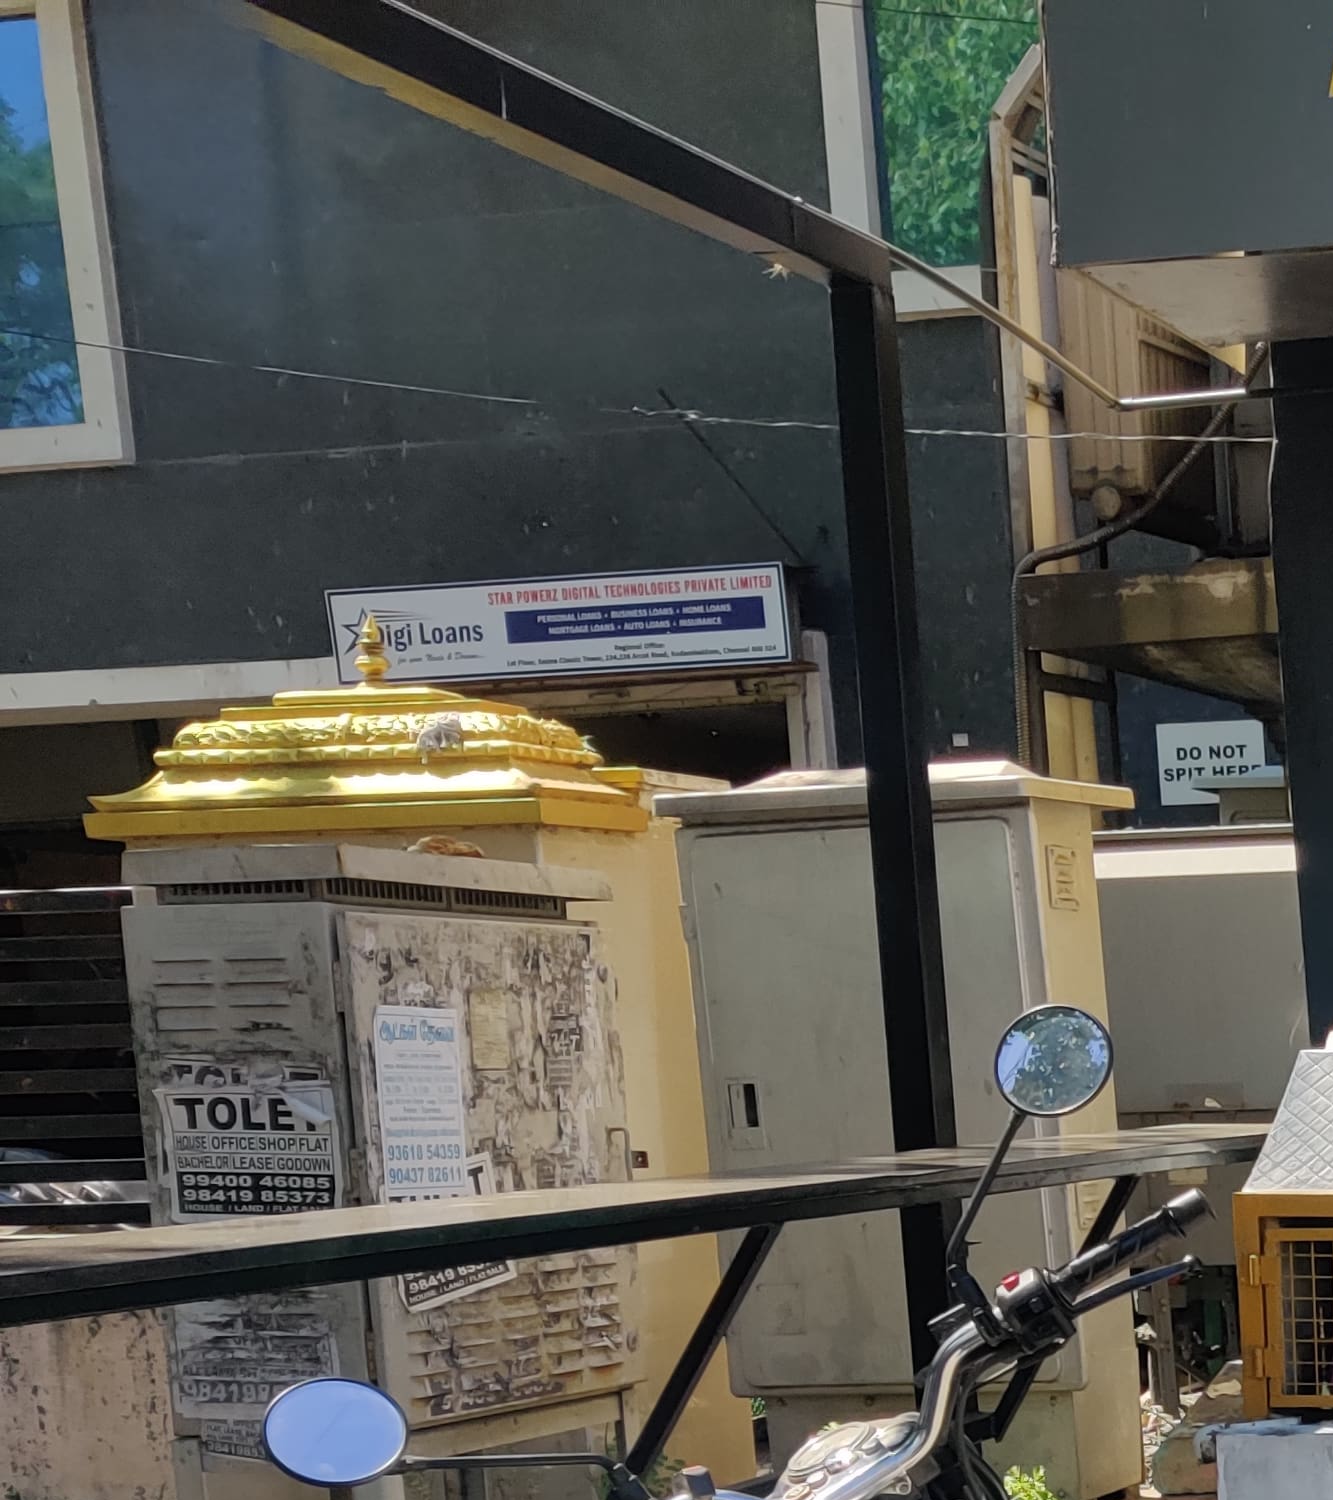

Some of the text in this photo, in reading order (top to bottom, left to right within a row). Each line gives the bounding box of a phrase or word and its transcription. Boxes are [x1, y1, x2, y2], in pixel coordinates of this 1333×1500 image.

[488, 575, 772, 605] STAR POWERZ DIGITAL TECHNOLOGIES PRIVATE LIMITED
[419, 623, 484, 645] Loans
[1176, 744, 1247, 761] DO NOT
[1164, 764, 1262, 782] SPIT HER
[173, 1097, 316, 1132] TOLE
[176, 1135, 329, 1153] HOUSE OFFICE SHOP FLAT
[178, 1156, 330, 1171] BACHELOR LEASE GODOWN
[182, 1175, 330, 1189] 99400 46085
[183, 1189, 330, 1203] 98419 85373
[234, 1204, 264, 1212] LAND
[409, 1269, 455, 1293] 98419
